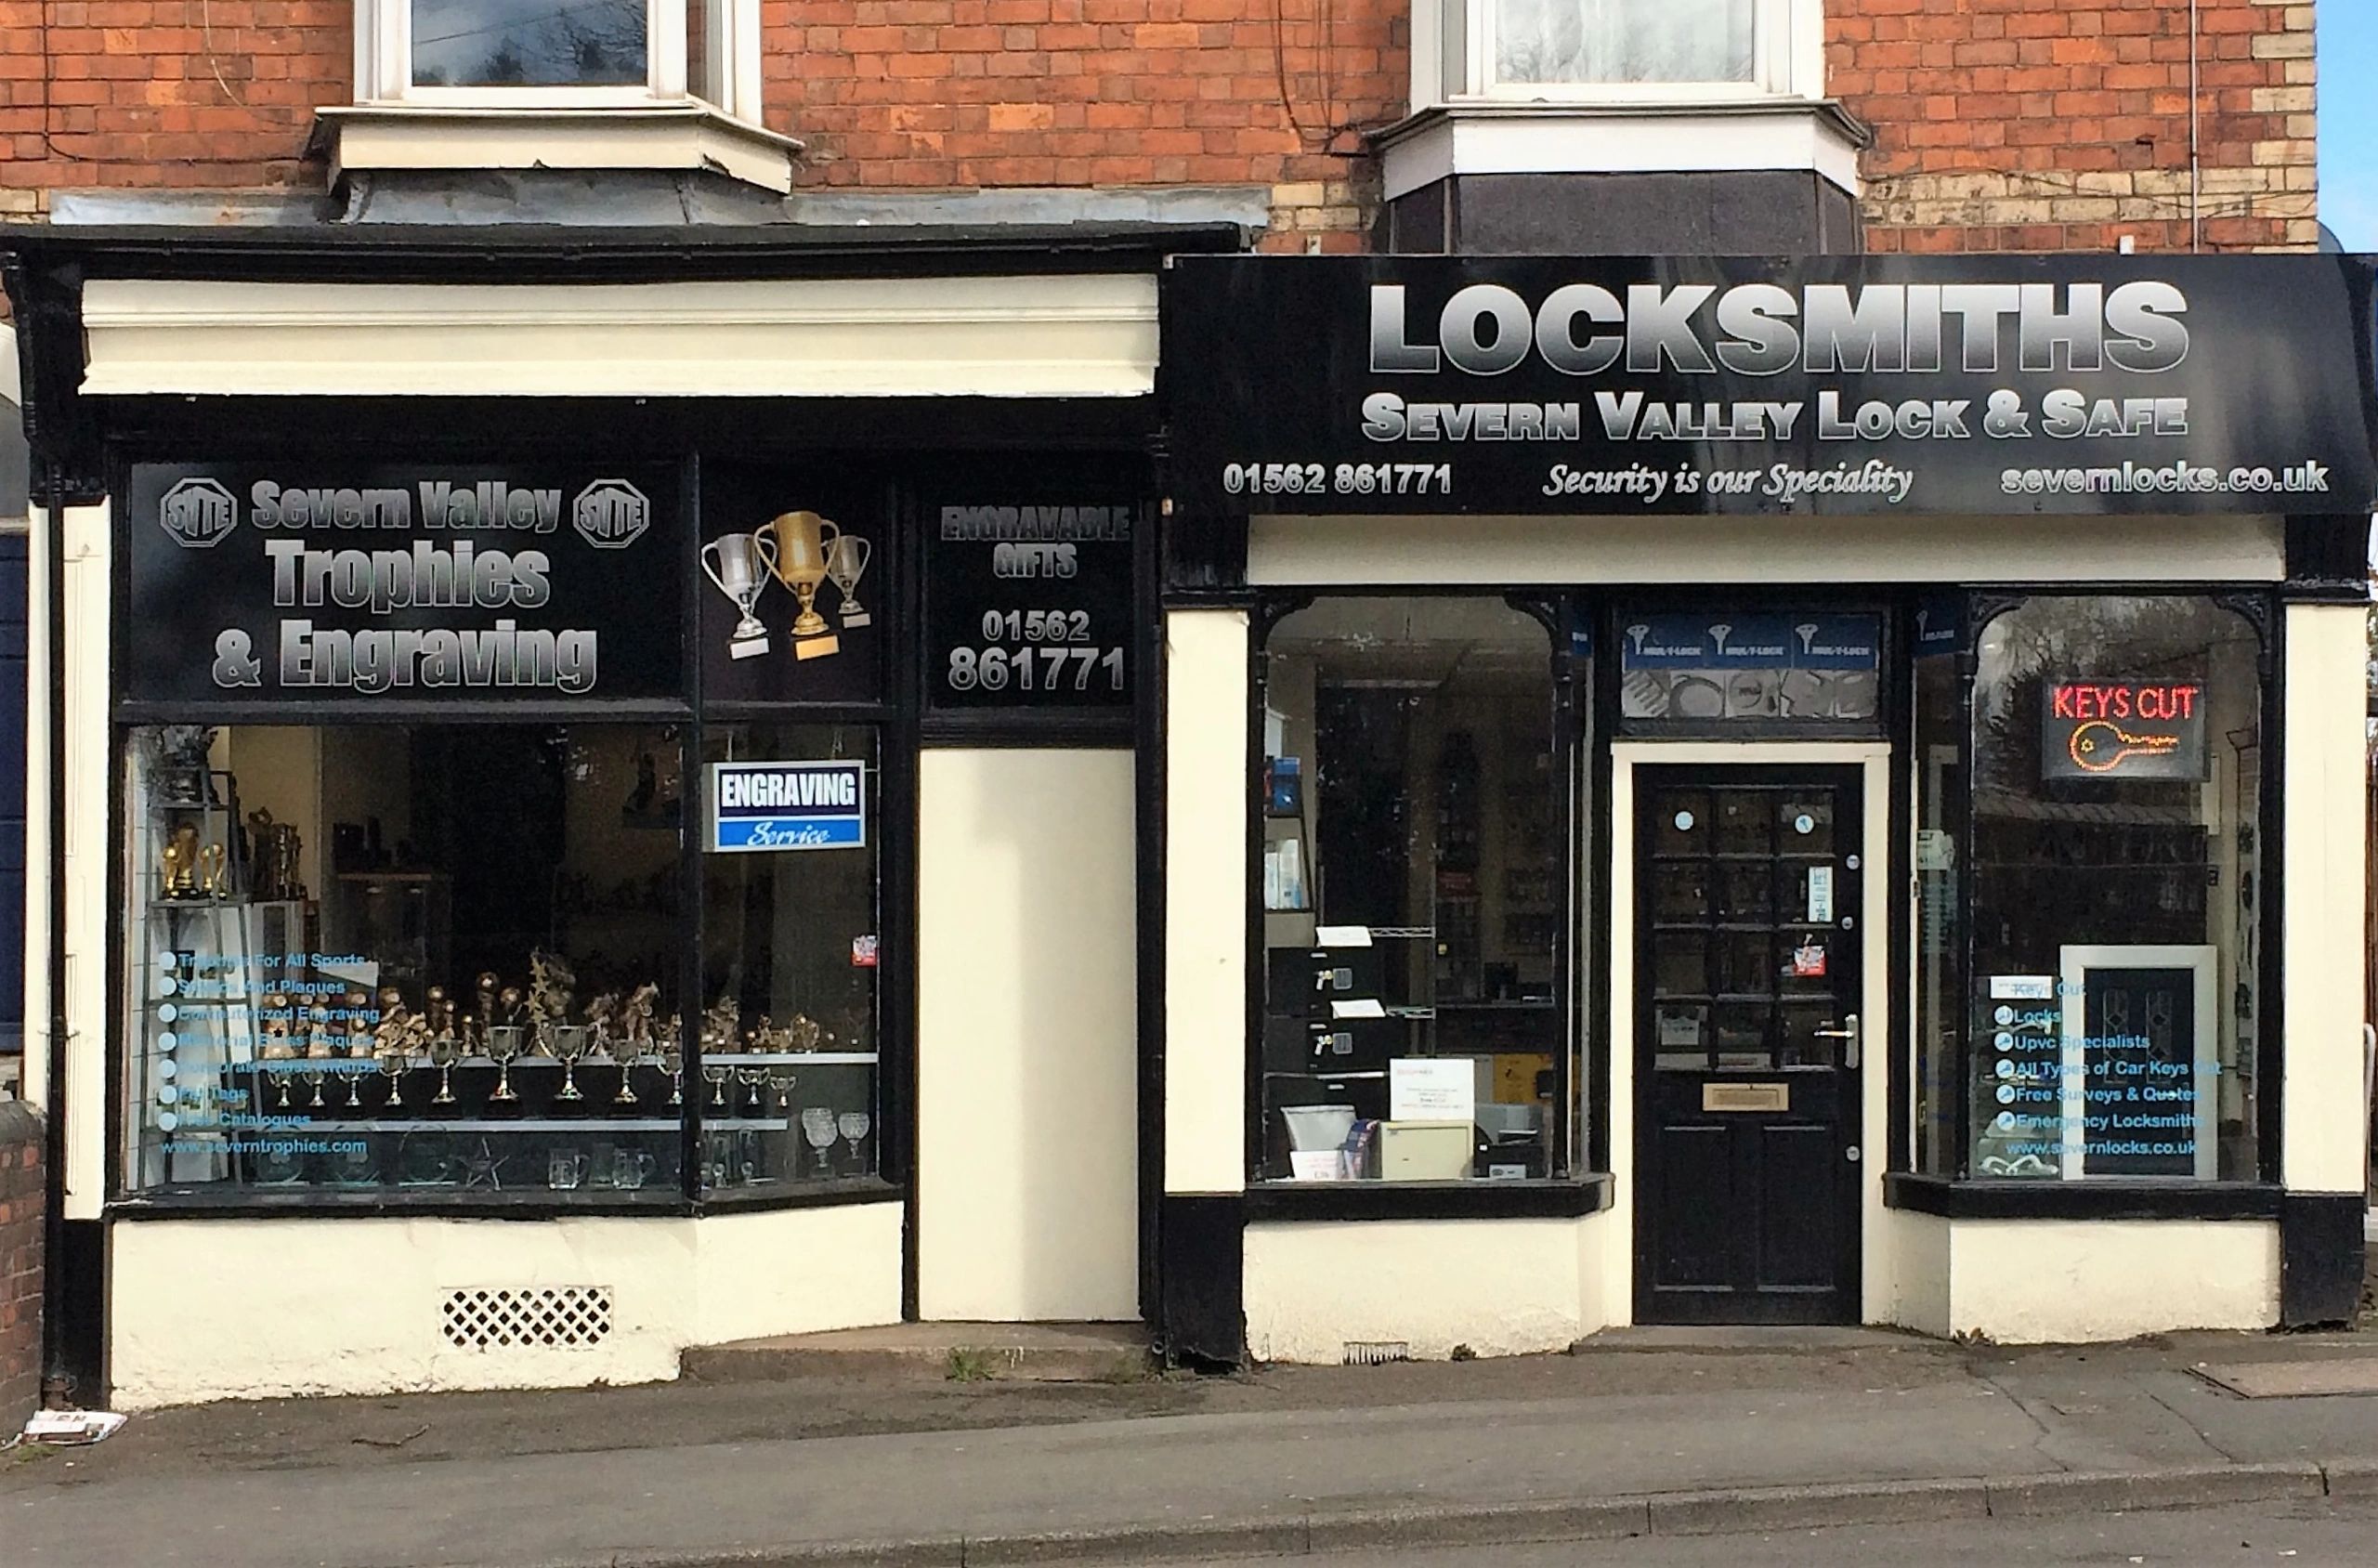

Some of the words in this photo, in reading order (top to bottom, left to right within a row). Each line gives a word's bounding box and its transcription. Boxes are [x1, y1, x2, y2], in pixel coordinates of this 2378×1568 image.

[1369, 281, 2190, 376] LOCKSMITHS
[1362, 392, 1579, 442] SEVERN
[1594, 390, 1804, 441] VALLEY
[1817, 390, 1971, 440] LOCK
[1982, 388, 2032, 438] &
[2042, 388, 2189, 438] SAFE
[1222, 463, 1326, 495] 01562
[1334, 463, 1452, 495] 861771
[1542, 462, 1668, 503] Security
[1674, 461, 1699, 493] is
[1705, 470, 1762, 493] our
[1762, 459, 1914, 504] Speciality
[2001, 460, 2329, 495] severnlocks.co.uk
[251, 480, 411, 529] Severn
[418, 480, 563, 533] Valley
[941, 505, 1130, 542] ENGRAVABLE
[993, 542, 1078, 579] GIFTS
[265, 540, 551, 615] Trophies
[982, 609, 1091, 642] 01562
[213, 629, 262, 687] &
[280, 619, 597, 694] Engraving
[947, 647, 1125, 691] 861771
[2053, 684, 2132, 719] KEYS
[2136, 685, 2199, 721] CUT
[720, 772, 856, 808] ENGRAVING
[746, 819, 831, 846] Service
[255, 953, 281, 968] For
[284, 953, 307, 967] All
[310, 953, 366, 970] Sports
[280, 980, 346, 997] Plaques
[2014, 983, 2052, 1000] Key
[297, 1006, 381, 1024] Engraving
[2014, 1008, 2061, 1024] Locks
[2014, 1035, 2057, 1052] Upvc
[2060, 1034, 2151, 1052] Specialists
[2015, 1061, 2037, 1076] All
[2041, 1061, 2090, 1078] Types
[2094, 1061, 2110, 1076] of
[2115, 1060, 2144, 1076] Car
[2149, 1060, 2189, 1078] Keys
[2016, 1087, 2052, 1102] Free
[2056, 1087, 2123, 1105] Surveys
[2126, 1087, 2139, 1102] &
[2143, 1087, 2202, 1103] Quotes
[218, 1113, 311, 1130] Catalogues
[2016, 1114, 2110, 1131] Emergency
[160, 1137, 367, 1156] www.severntrophies.com
[2006, 1141, 2198, 1156] www.severnlocks.co.uk
